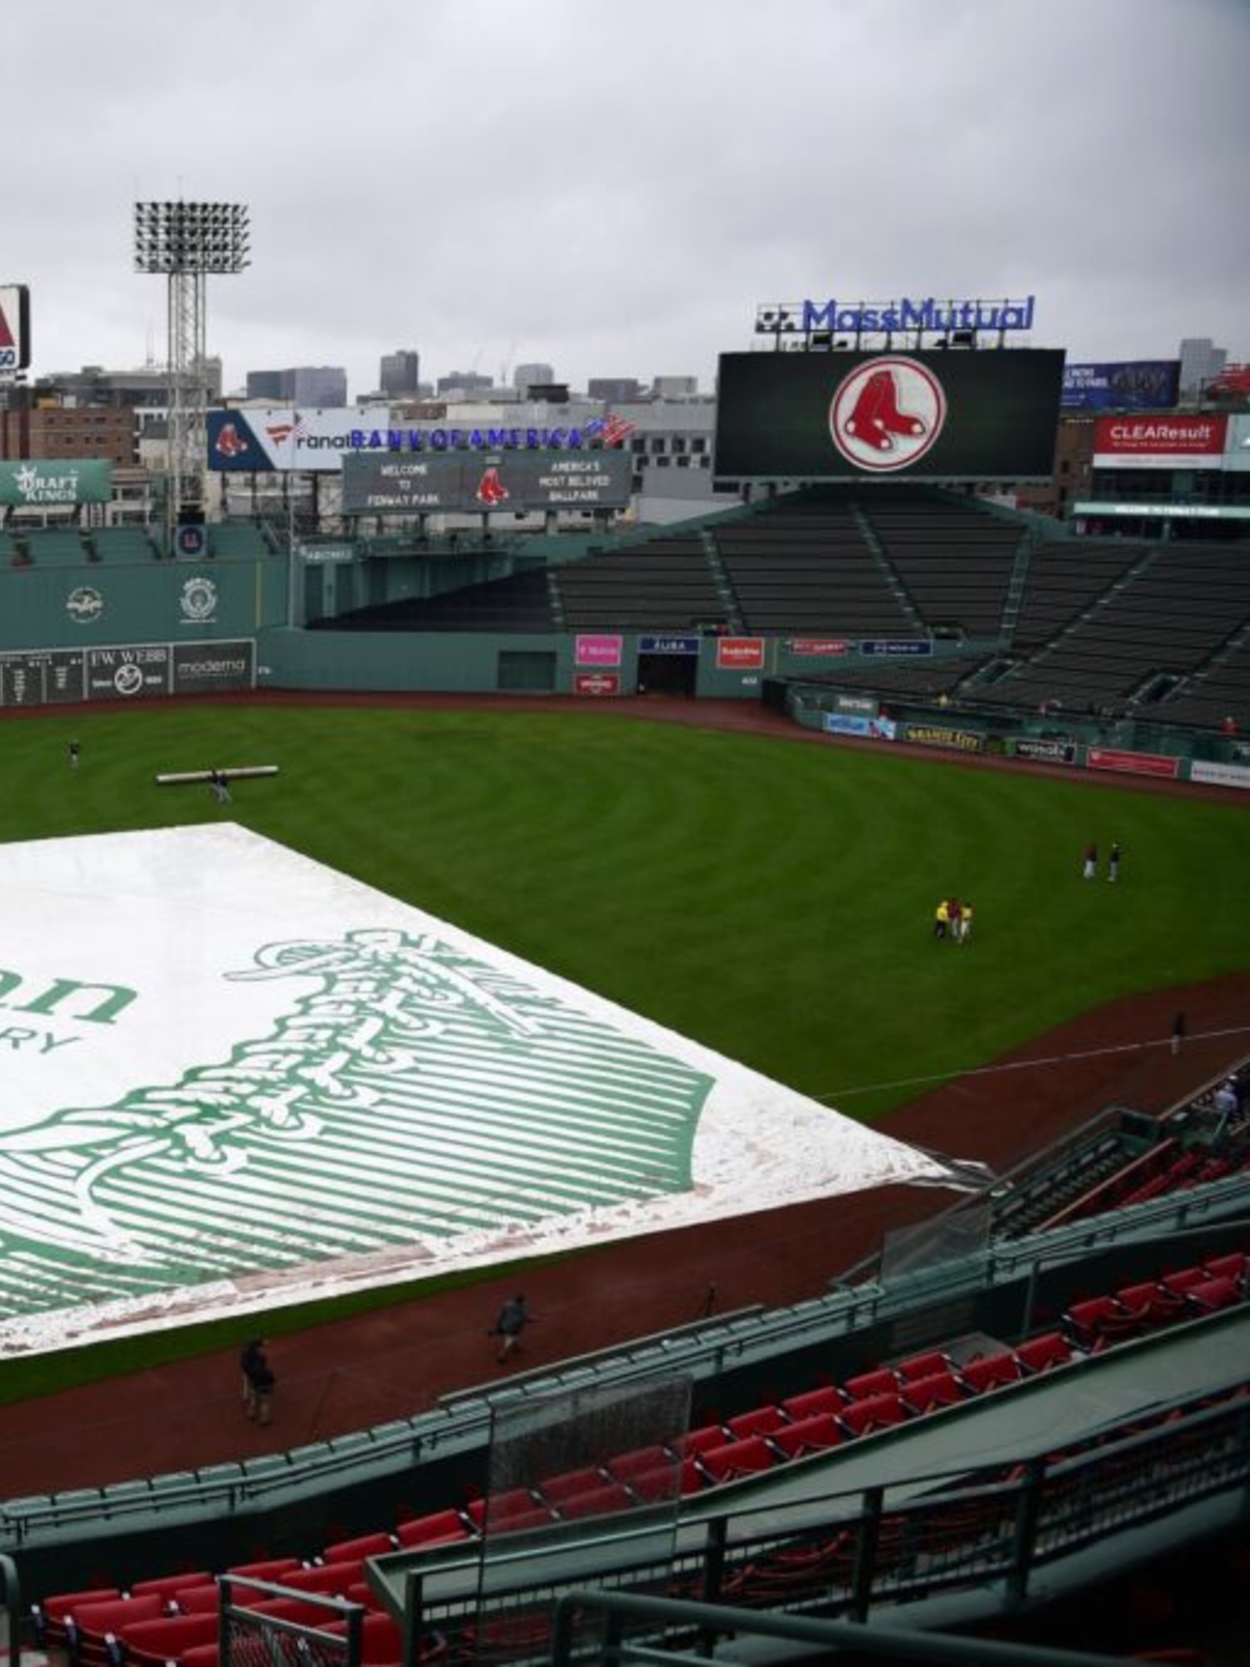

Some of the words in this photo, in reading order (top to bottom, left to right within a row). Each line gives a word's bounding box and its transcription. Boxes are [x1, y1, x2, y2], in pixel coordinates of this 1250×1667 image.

[803, 296, 1035, 331] MassMutual
[1110, 425, 1210, 440] CLEAResult
[351, 429, 421, 450] BANK
[430, 429, 462, 450] OF
[469, 429, 582, 450] AMERICA
[381, 465, 428, 477] WELCOME
[23, 476, 78, 490] DRAFT
[399, 480, 410, 490] TO
[540, 476, 566, 486] MOST
[26, 489, 77, 500] KINGS
[368, 495, 409, 506] FENWAY
[412, 495, 440, 505] PARK
[549, 490, 598, 501] BALLPARK
[121, 650, 166, 663] WEBB
[178, 659, 245, 674] moderna
